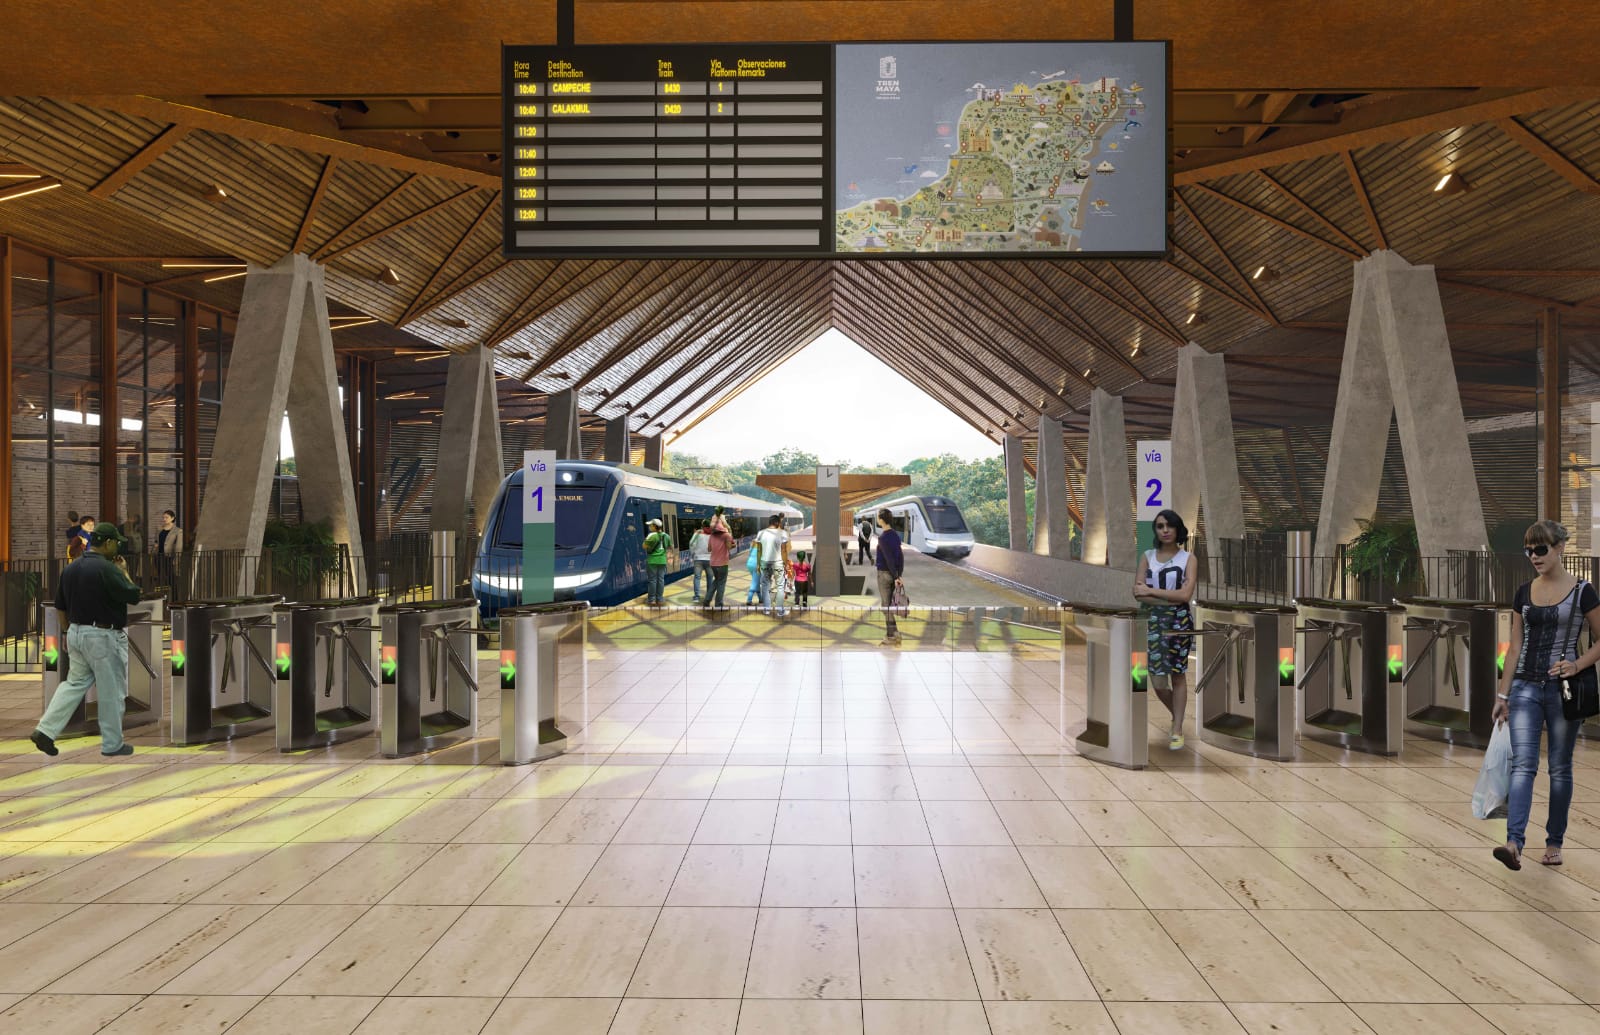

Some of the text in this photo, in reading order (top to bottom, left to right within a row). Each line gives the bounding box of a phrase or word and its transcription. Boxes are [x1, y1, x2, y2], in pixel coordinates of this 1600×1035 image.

[514, 60, 530, 70] Hora
[548, 60, 572, 70] Destino
[658, 60, 672, 69] Tren
[738, 59, 786, 69] Observaciones
[514, 70, 530, 78] Time
[548, 69, 584, 78] Destination
[658, 68, 674, 78] Train
[710, 68, 736, 77] Platform
[738, 68, 766, 77] Remarks
[552, 83, 592, 93] CAMPECHE
[718, 82, 722, 92] 1
[552, 104, 591, 114] CALAKMUL
[718, 103, 722, 112] 2
[519, 126, 537, 136] 11:20
[519, 168, 537, 176] 12:00
[519, 188, 537, 198] 12:00
[519, 210, 537, 219] 12:00
[1146, 478, 1162, 506] 2
[532, 486, 543, 512] 1
